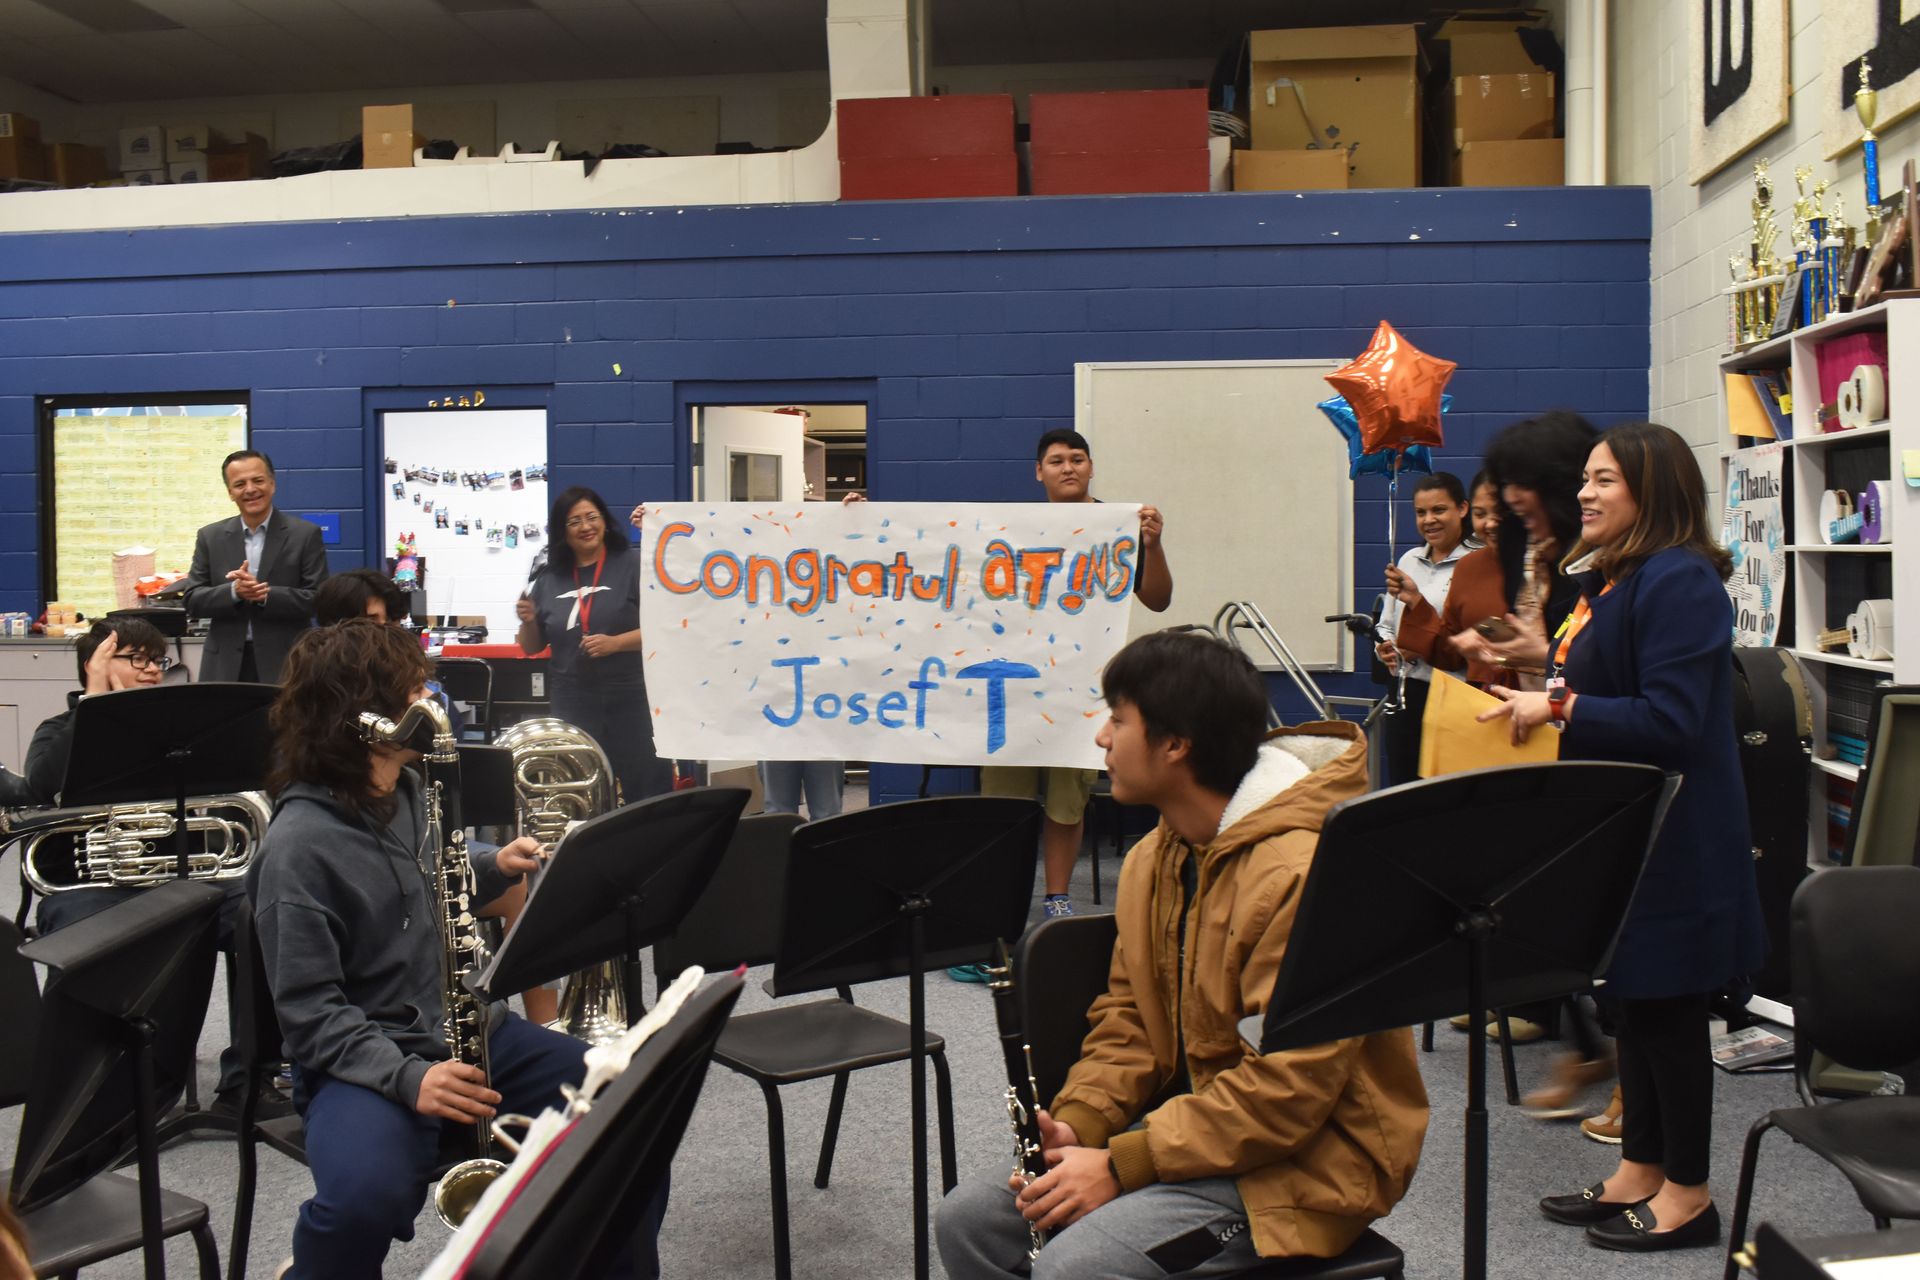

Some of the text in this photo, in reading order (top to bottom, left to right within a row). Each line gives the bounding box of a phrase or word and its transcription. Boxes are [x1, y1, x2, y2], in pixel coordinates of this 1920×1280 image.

[1737, 467, 1780, 502] Thanks
[1744, 510, 1765, 543] For
[1743, 555, 1761, 586] All
[761, 655, 1041, 755] Josef T
